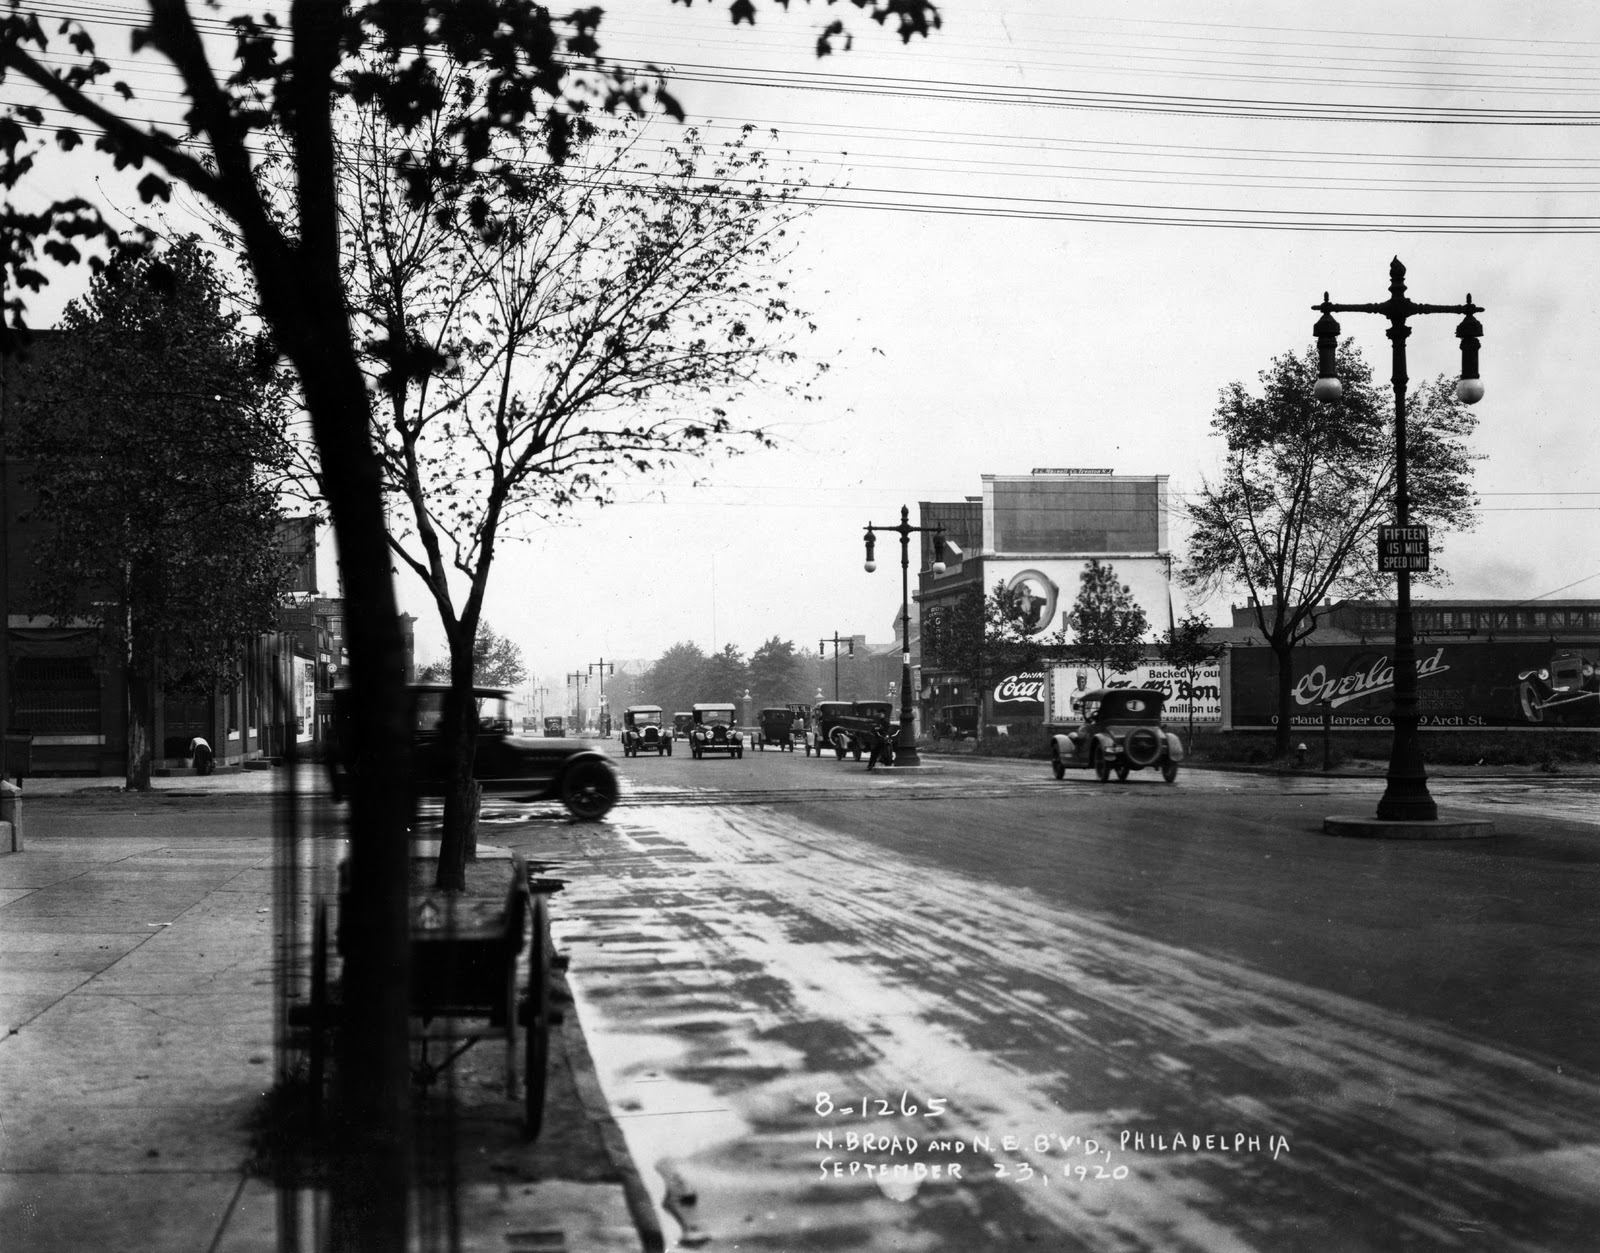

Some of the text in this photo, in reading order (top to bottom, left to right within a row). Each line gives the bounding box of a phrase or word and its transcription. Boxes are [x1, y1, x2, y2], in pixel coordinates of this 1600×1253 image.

[1384, 528, 1426, 540] FIFTEEN
[1386, 542, 1425, 554] (15) MILE
[1383, 556, 1428, 569] SPEED LIMIT
[1018, 671, 1045, 679] DRIN
[1149, 669, 1187, 679] Backed
[1169, 703, 1204, 713] million
[1373, 714, 1395, 726] Co.
[1430, 714, 1464, 726] Arch
[1467, 714, 1487, 726] St.
